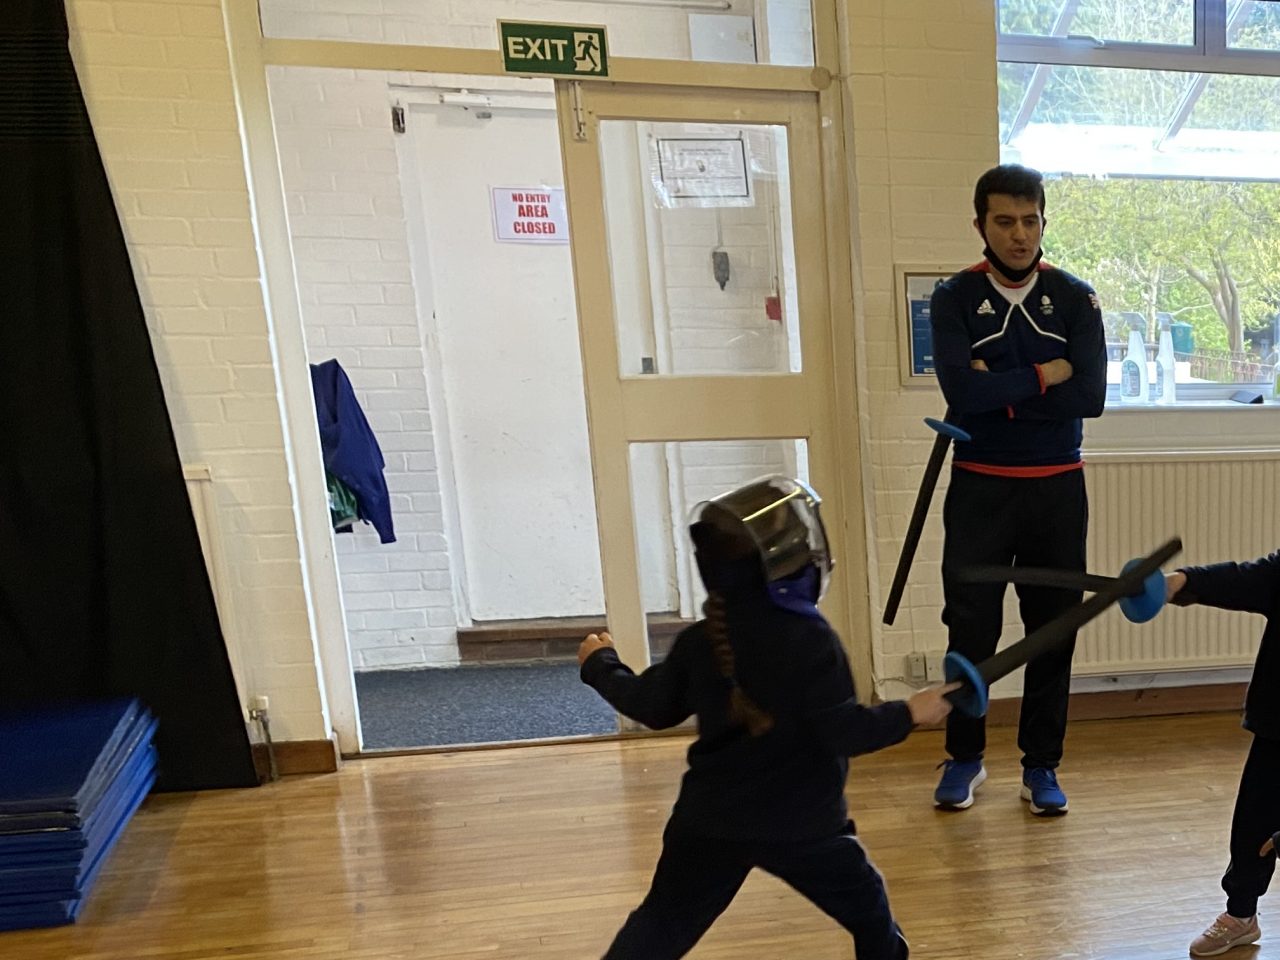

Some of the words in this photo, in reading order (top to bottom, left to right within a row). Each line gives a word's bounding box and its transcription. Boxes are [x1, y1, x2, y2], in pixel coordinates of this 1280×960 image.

[507, 36, 568, 61] EXIT
[511, 193, 524, 203] NO
[525, 193, 551, 204] ENTRY
[518, 204, 549, 218] AREA
[513, 221, 556, 234] CLOSED
